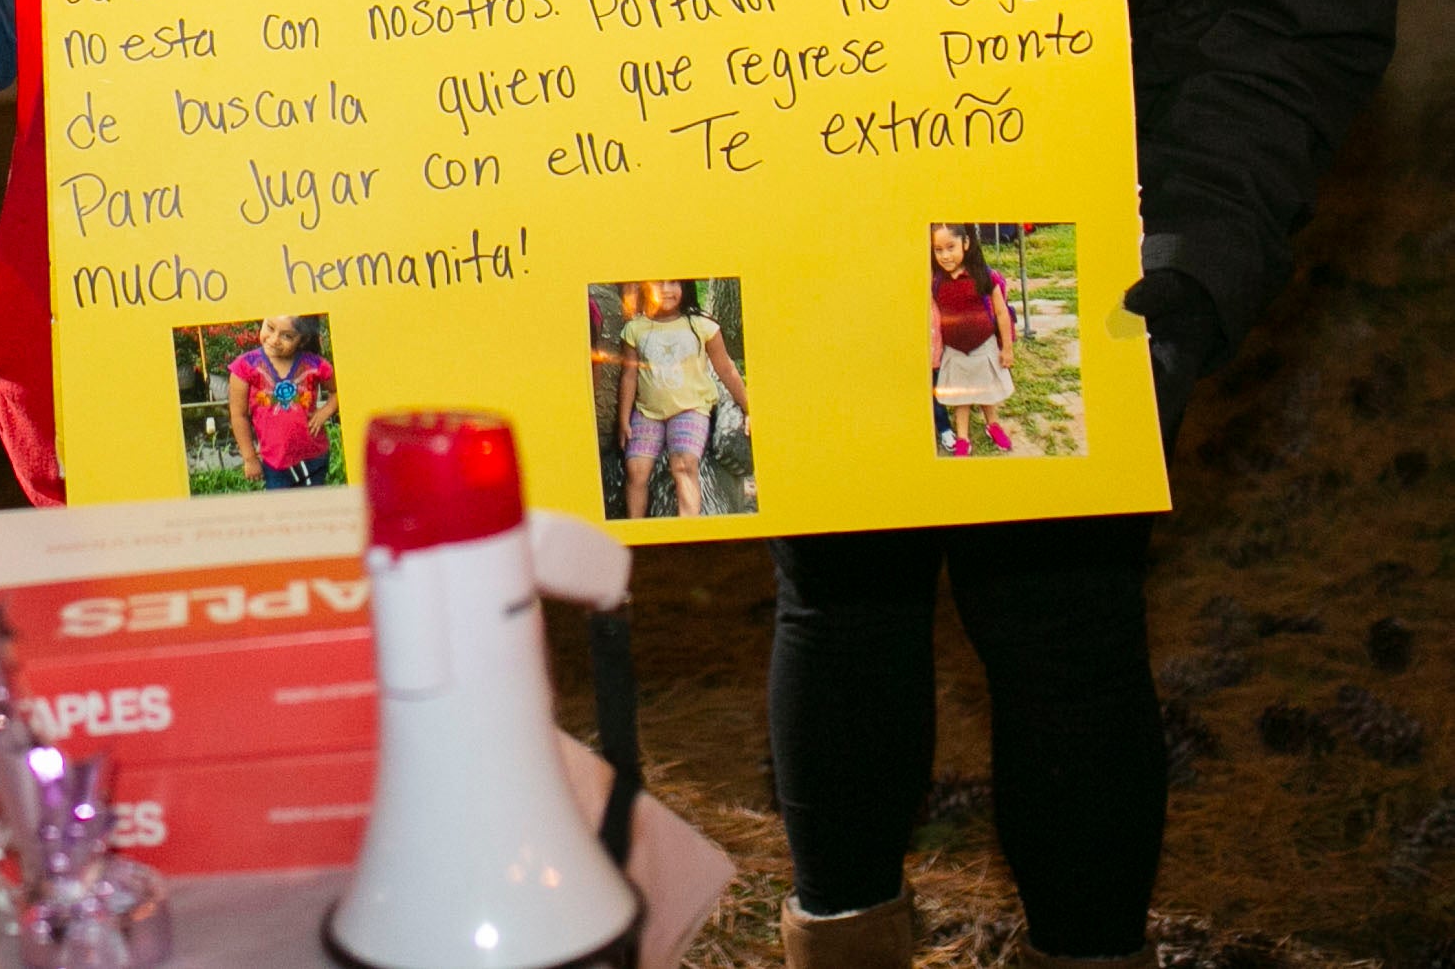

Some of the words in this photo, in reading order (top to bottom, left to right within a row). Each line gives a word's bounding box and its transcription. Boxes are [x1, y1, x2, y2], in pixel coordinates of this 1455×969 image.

[64, 29, 107, 69] no
[118, 17, 217, 62] esta
[66, 91, 120, 150] de
[174, 80, 368, 136] buscarla
[438, 65, 576, 137] quiero
[619, 55, 692, 122] que
[726, 39, 888, 110] regrese
[669, 110, 763, 172] Te
[819, 86, 1024, 157] extraño
[73, 253, 228, 309] mucho
[282, 226, 529, 295] hermanita!
[58, 578, 371, 639] APLES
[16, 684, 174, 743] APLES
